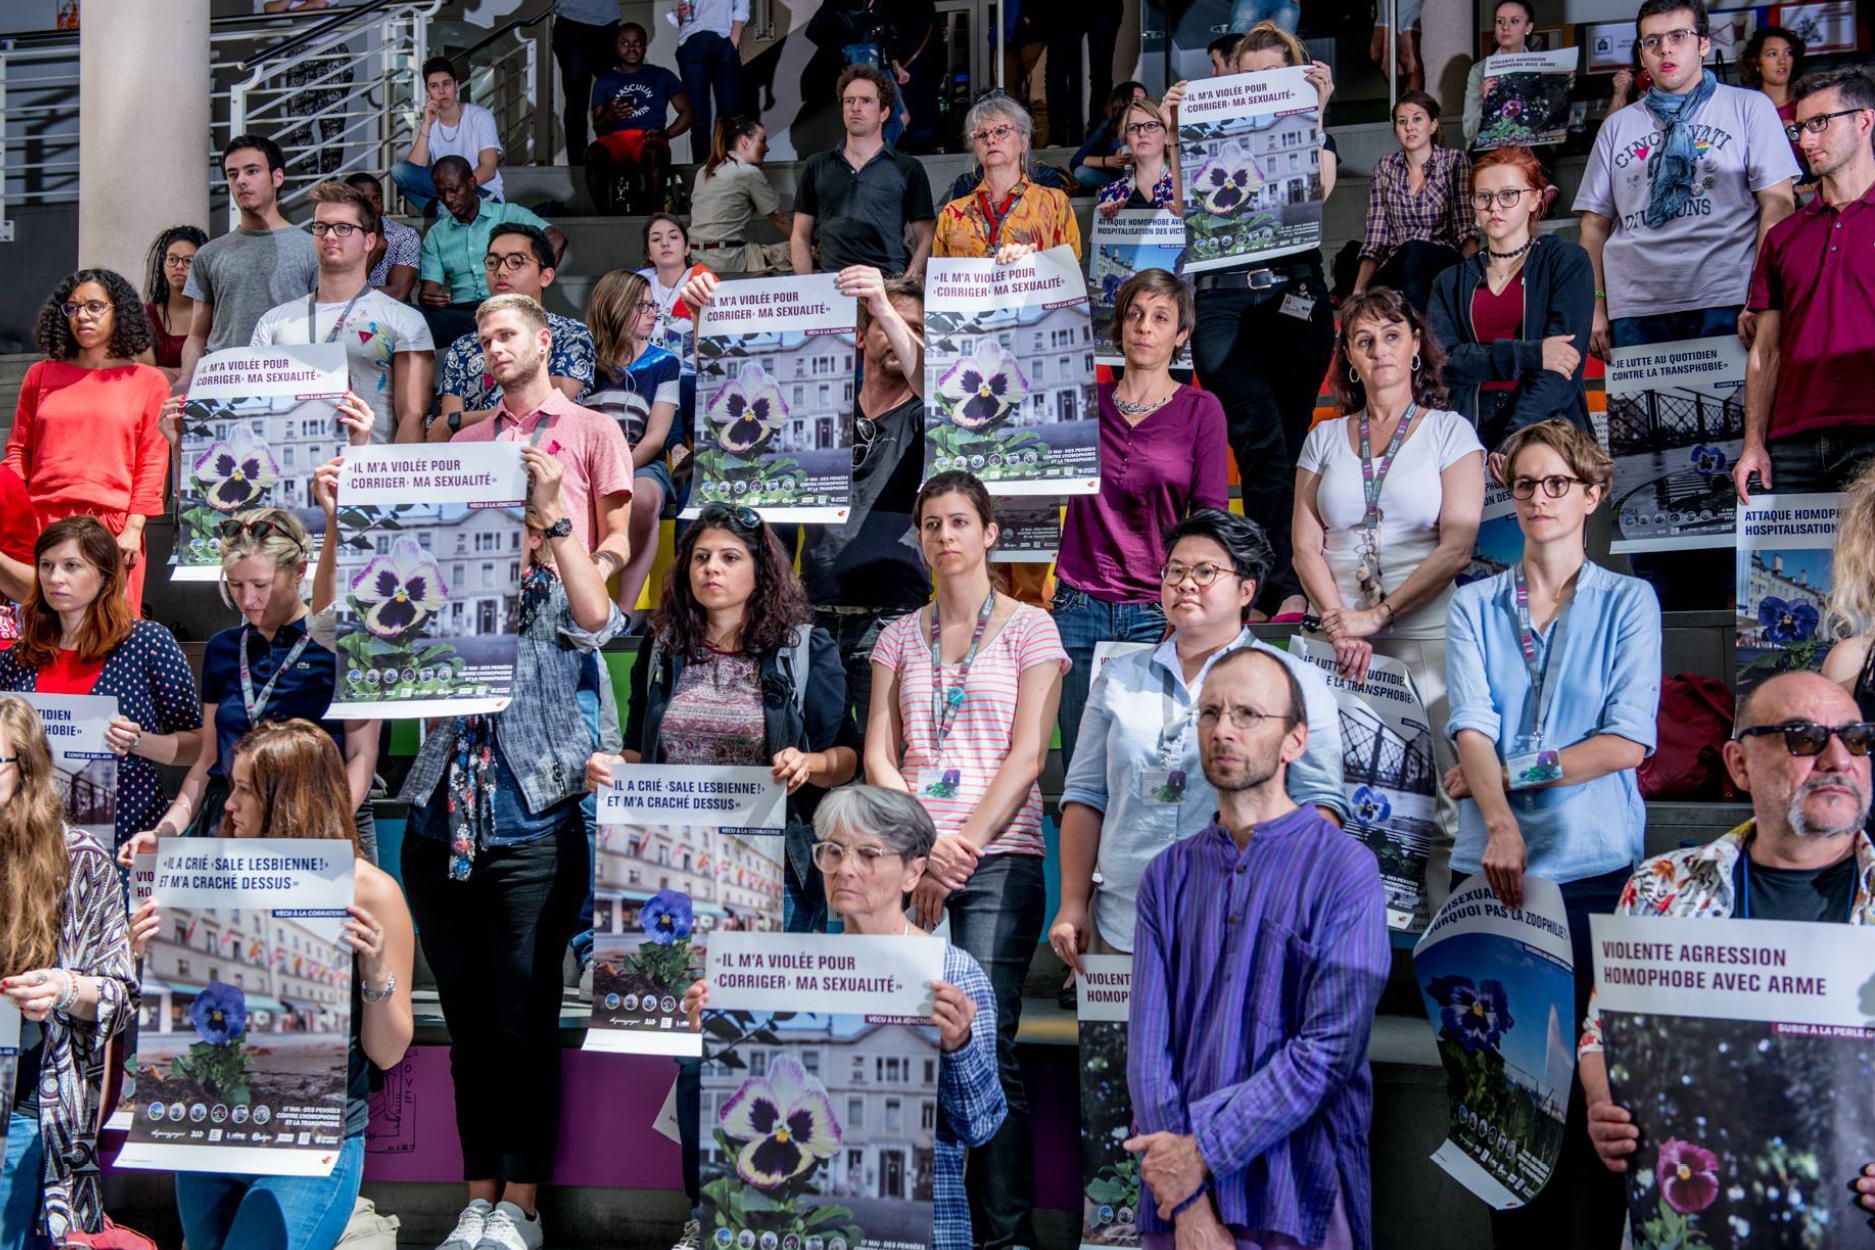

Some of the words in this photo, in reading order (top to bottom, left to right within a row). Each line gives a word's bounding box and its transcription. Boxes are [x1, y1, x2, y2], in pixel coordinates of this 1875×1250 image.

[1198, 92, 1213, 100] M'A
[1216, 85, 1242, 98] VIOLÉE
[1245, 83, 1266, 93] POUR
[1233, 98, 1246, 106] MA
[1625, 198, 1711, 231] DIVONS
[1098, 218, 1126, 226] ATTAQUE
[952, 272, 970, 282] M'A
[974, 269, 1005, 283] VIOLÉE
[1009, 268, 1035, 279] POUR
[994, 285, 1009, 296] MA
[720, 296, 736, 306] M'A
[740, 292, 770, 304] VIOLÉE
[774, 292, 798, 302] POUR
[758, 308, 773, 318] MA
[210, 362, 225, 371] M'A
[229, 358, 260, 370] VIOLÉE
[264, 359, 289, 368] POUR
[1627, 357, 1652, 368] LUTTE
[1655, 356, 1666, 364] AU
[1670, 350, 1717, 363] QUOTIDIEN
[248, 374, 262, 383] MA
[1612, 370, 1644, 381] CONTRE
[1647, 368, 1657, 377] LA
[368, 461, 387, 472] M'A
[392, 458, 427, 472] VIOLÉE
[431, 460, 460, 471] POUR
[414, 476, 430, 487] MA
[1496, 491, 1511, 502] DES
[1745, 510, 1791, 522] ATTAQUE
[1334, 678, 1344, 688] LA
[628, 781, 634, 791] A
[639, 778, 662, 792] CRIÉ
[607, 796, 620, 807] ET
[624, 796, 644, 808] M'A
[647, 795, 690, 809] CRACHÉ
[177, 858, 183, 870] A
[185, 854, 208, 870] CRIÉ
[159, 878, 168, 887] ET
[171, 877, 189, 888] M'A
[193, 874, 237, 889] CRACHÉ
[1485, 904, 1508, 918] PAS
[1512, 909, 1523, 922] LA
[739, 954, 764, 968] M'A
[769, 951, 814, 969] VIOLÉE
[819, 956, 856, 970] POUR
[1602, 941, 1673, 962] VIOLENTE
[1680, 945, 1786, 967] AGRESSION
[796, 976, 817, 990] MA
[1086, 973, 1131, 985] VIOLENT
[1604, 967, 1705, 989] HOMOPHOBE
[1712, 972, 1760, 992] AVEC
[1768, 975, 1826, 995] ARME
[1778, 1024, 1808, 1034] SUBIE
[1810, 1024, 1817, 1034] À
[1820, 1026, 1832, 1035] LA
[1834, 1027, 1864, 1037] PERLE
